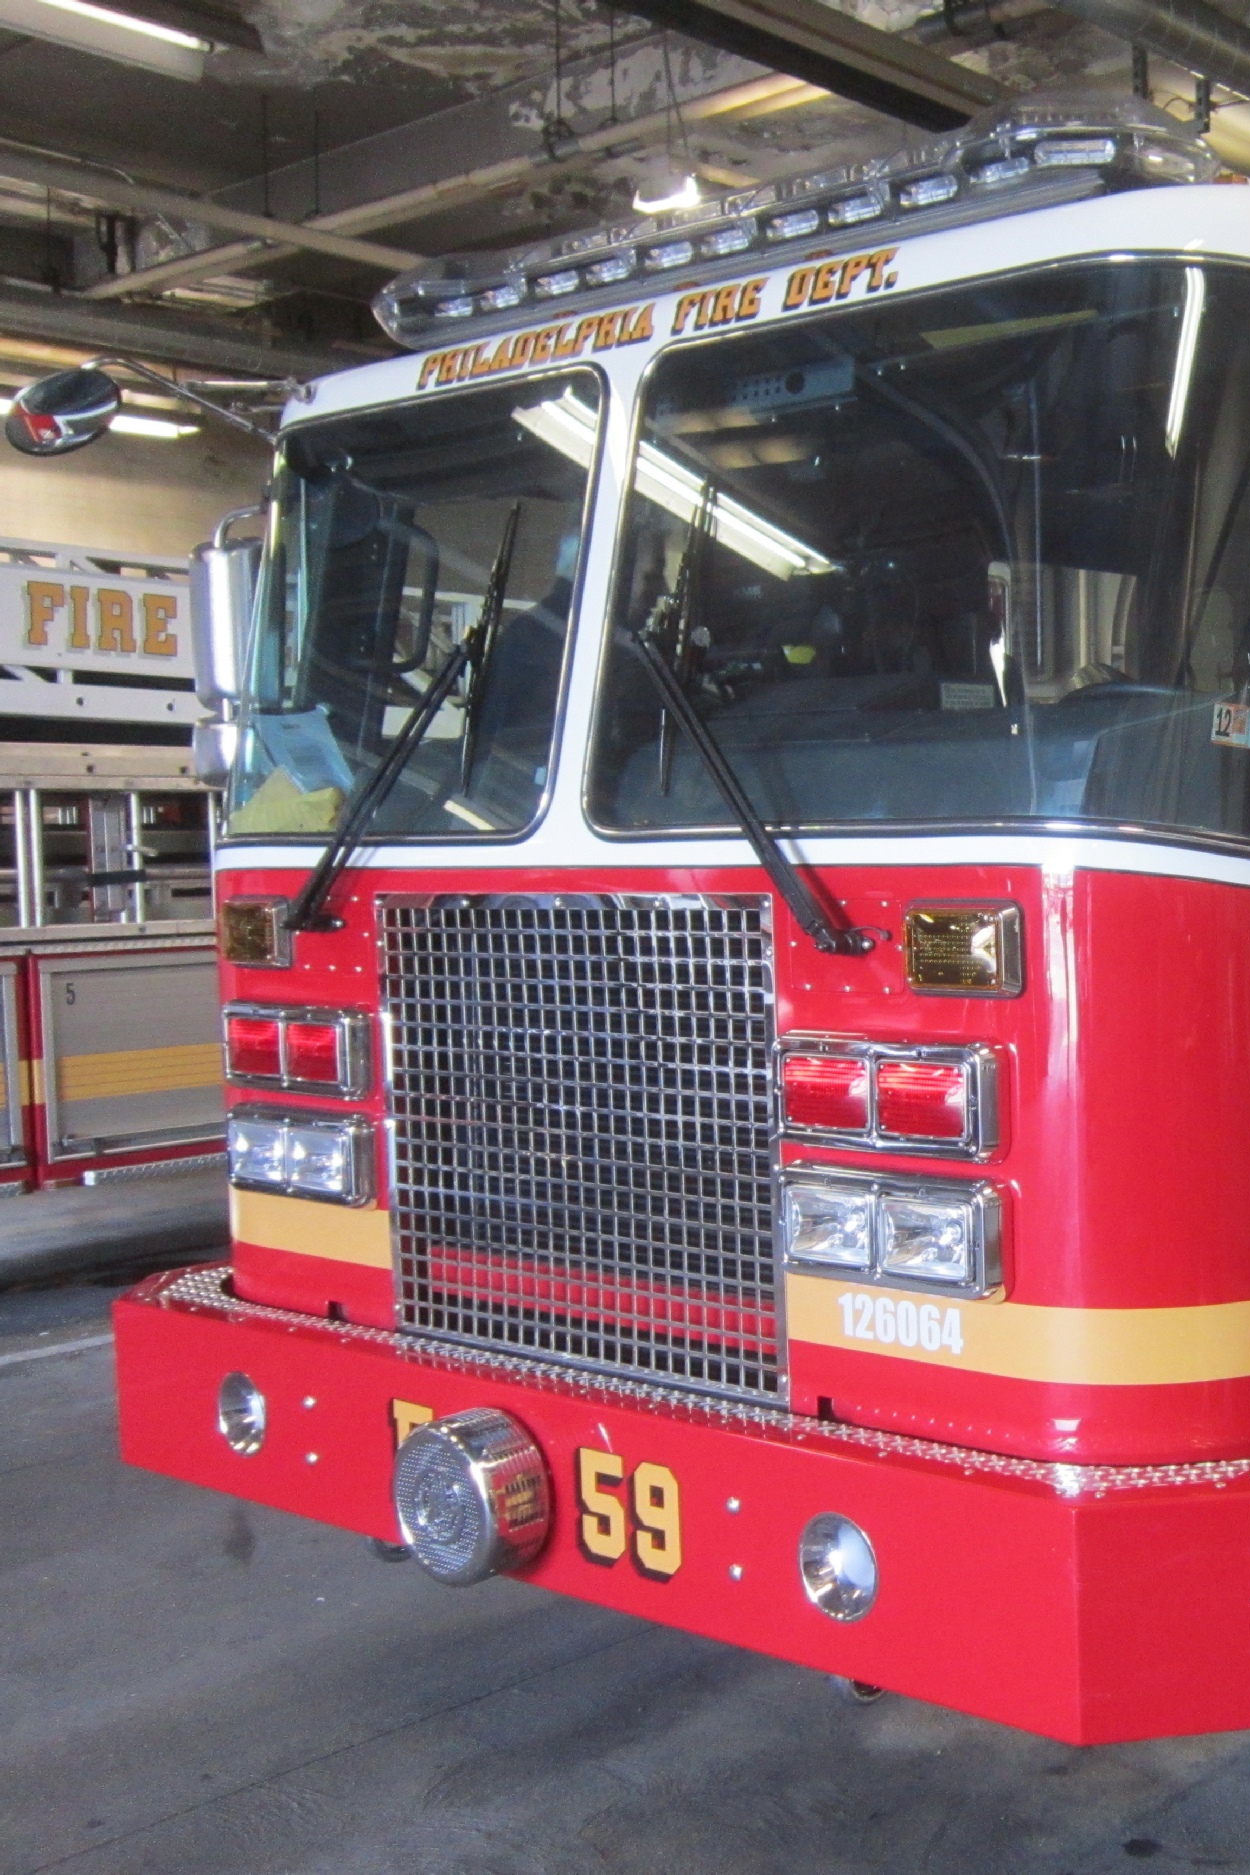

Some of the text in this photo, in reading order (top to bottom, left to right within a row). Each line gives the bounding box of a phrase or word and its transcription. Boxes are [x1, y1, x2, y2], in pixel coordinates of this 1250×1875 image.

[416, 247, 900, 390] PHILADELPHIA FIRE DEPT.
[24, 580, 178, 658] FIRE
[1215, 707, 1231, 737] 12
[65, 982, 76, 1005] 5
[838, 1292, 964, 1355] 126064
[577, 1447, 682, 1582] 59
